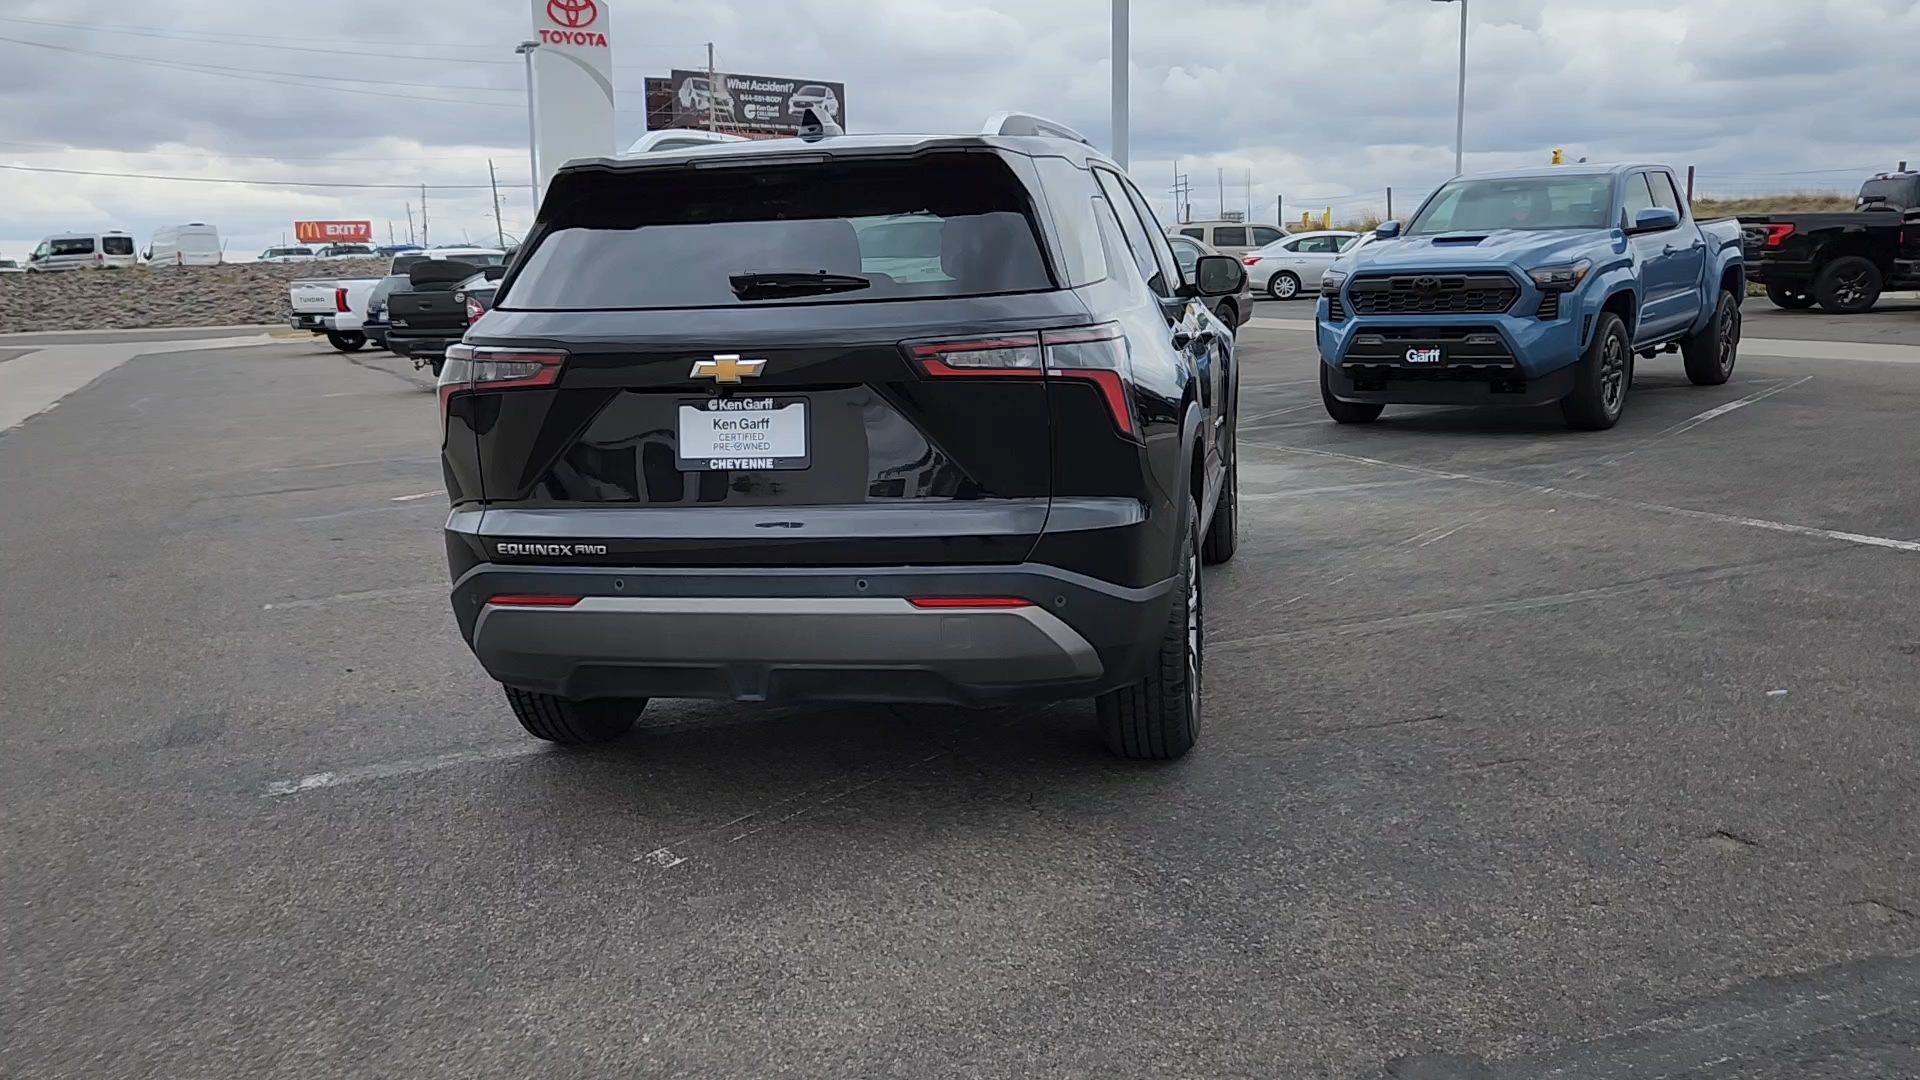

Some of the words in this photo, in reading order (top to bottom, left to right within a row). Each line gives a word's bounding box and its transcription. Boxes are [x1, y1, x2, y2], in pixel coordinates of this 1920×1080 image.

[539, 30, 607, 47] TOYOTA
[727, 78, 750, 90] What
[751, 80, 795, 93] Accident?
[326, 225, 356, 235] EXIT
[358, 225, 366, 235] 7
[1406, 349, 1440, 362] Garff
[719, 399, 742, 410] Ken
[743, 399, 773, 410] Garff
[713, 418, 737, 430] Ken
[739, 418, 770, 430] Garff
[719, 433, 764, 442] CERTIFIED
[710, 458, 773, 469] CHEYENNE
[497, 543, 572, 556] EQUINOX
[574, 544, 606, 555] AWD
